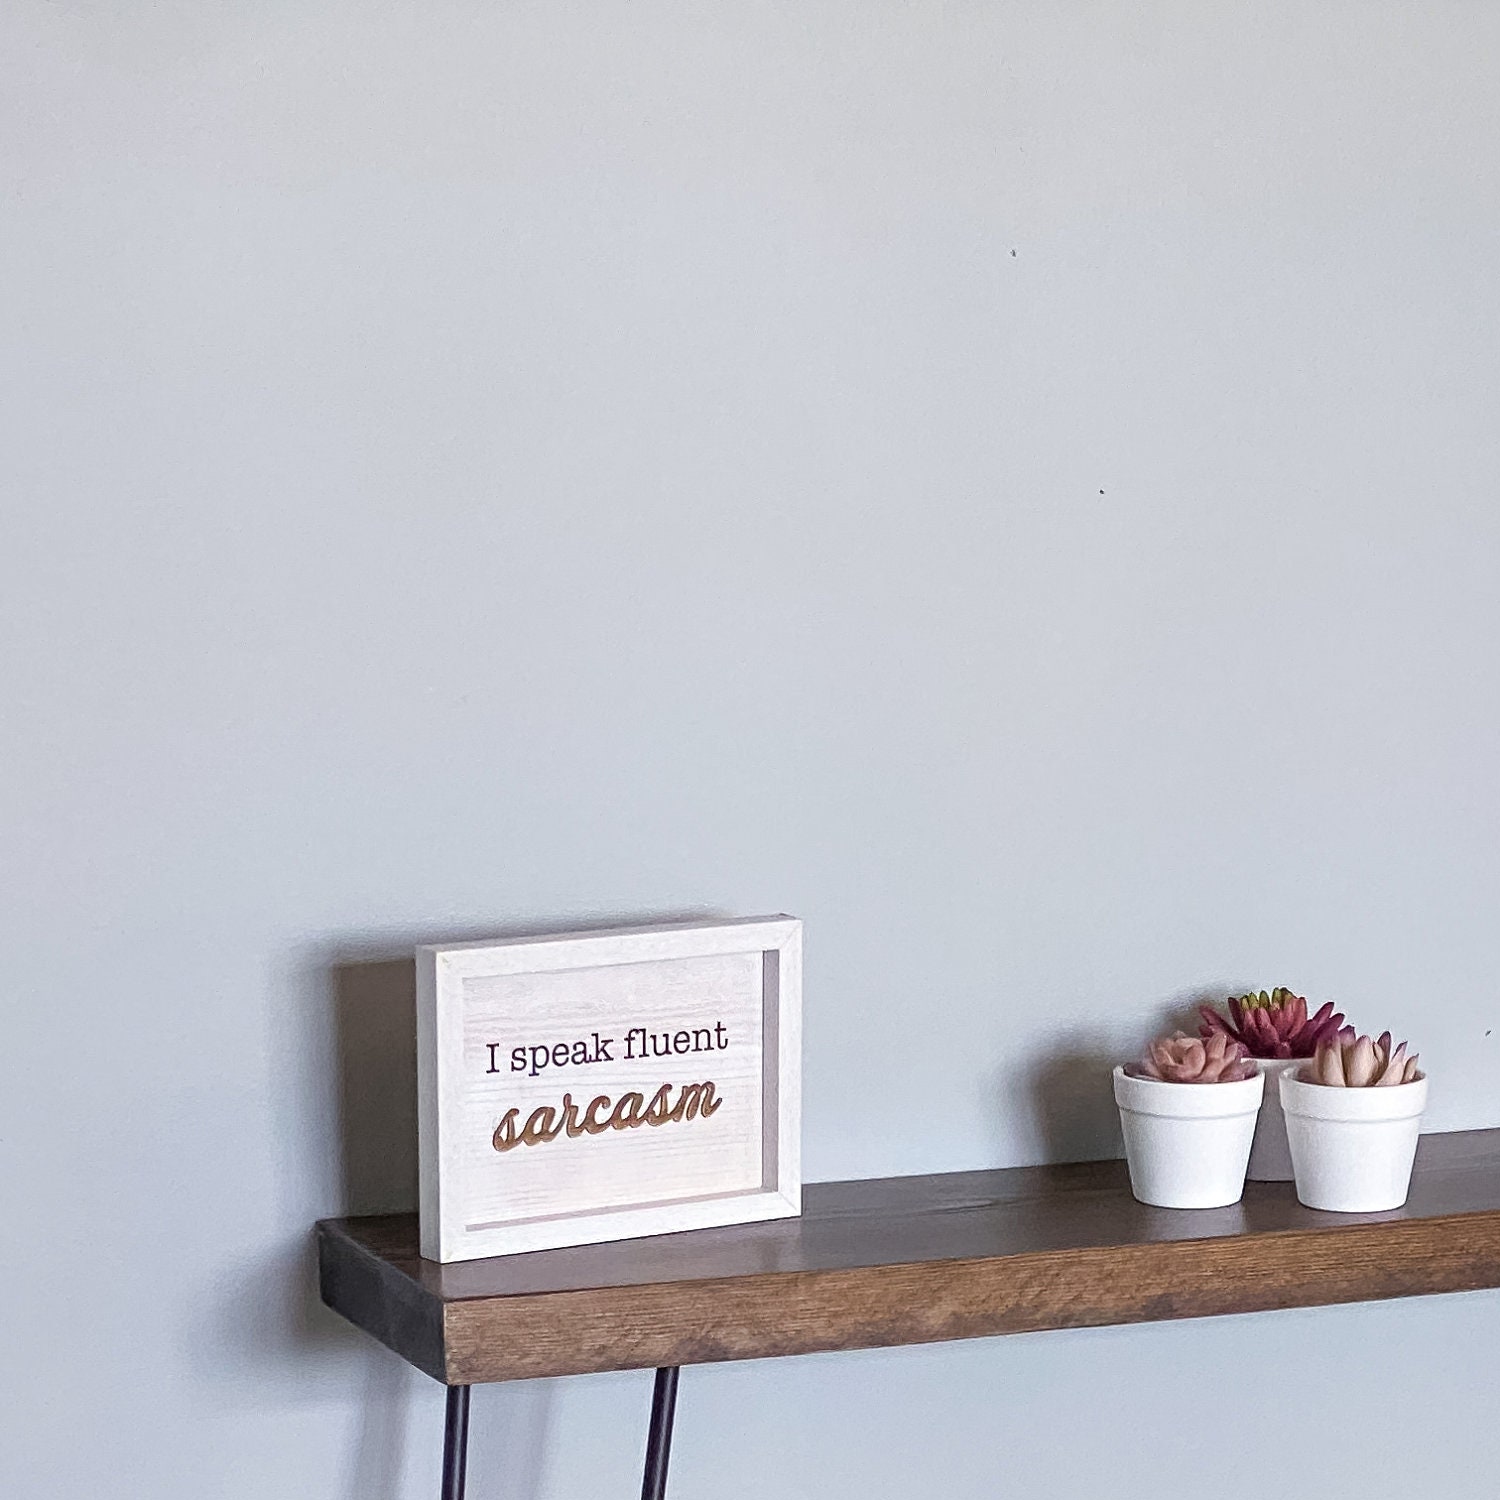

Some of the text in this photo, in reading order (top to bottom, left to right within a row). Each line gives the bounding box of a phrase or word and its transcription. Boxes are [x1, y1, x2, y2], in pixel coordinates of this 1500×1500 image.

[485, 1021, 729, 1077] I speak fluent
[492, 1080, 723, 1152] sarcasm
